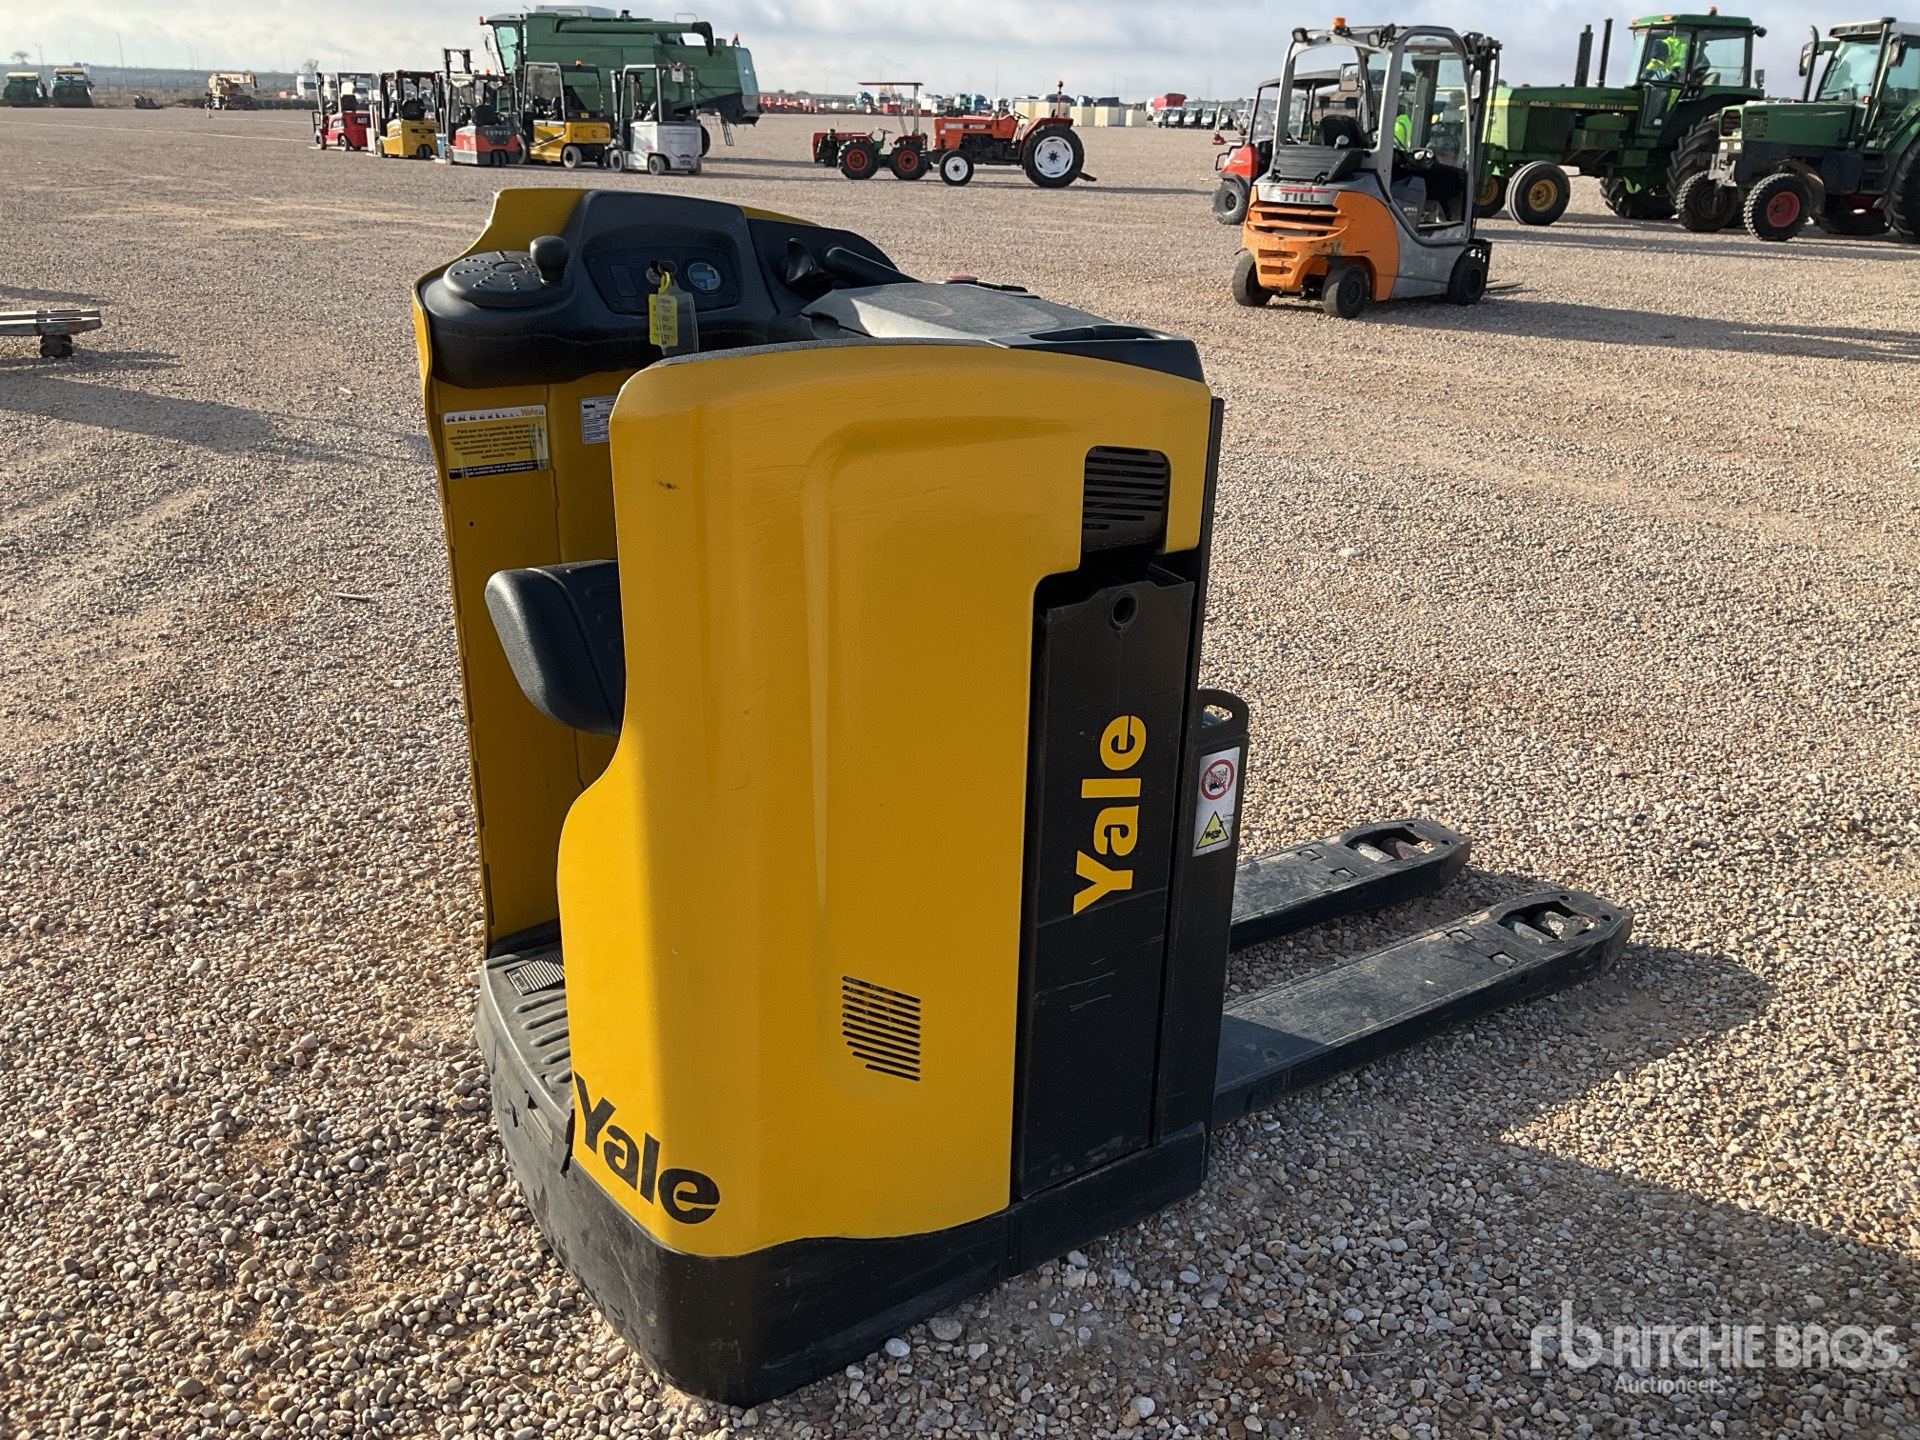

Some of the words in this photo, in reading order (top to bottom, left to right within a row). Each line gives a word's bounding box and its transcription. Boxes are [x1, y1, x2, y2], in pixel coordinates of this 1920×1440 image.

[1269, 191, 1321, 203] STILL
[521, 408, 538, 417] Yale
[1073, 715, 1147, 915] Yale
[573, 1070, 721, 1225] Yale
